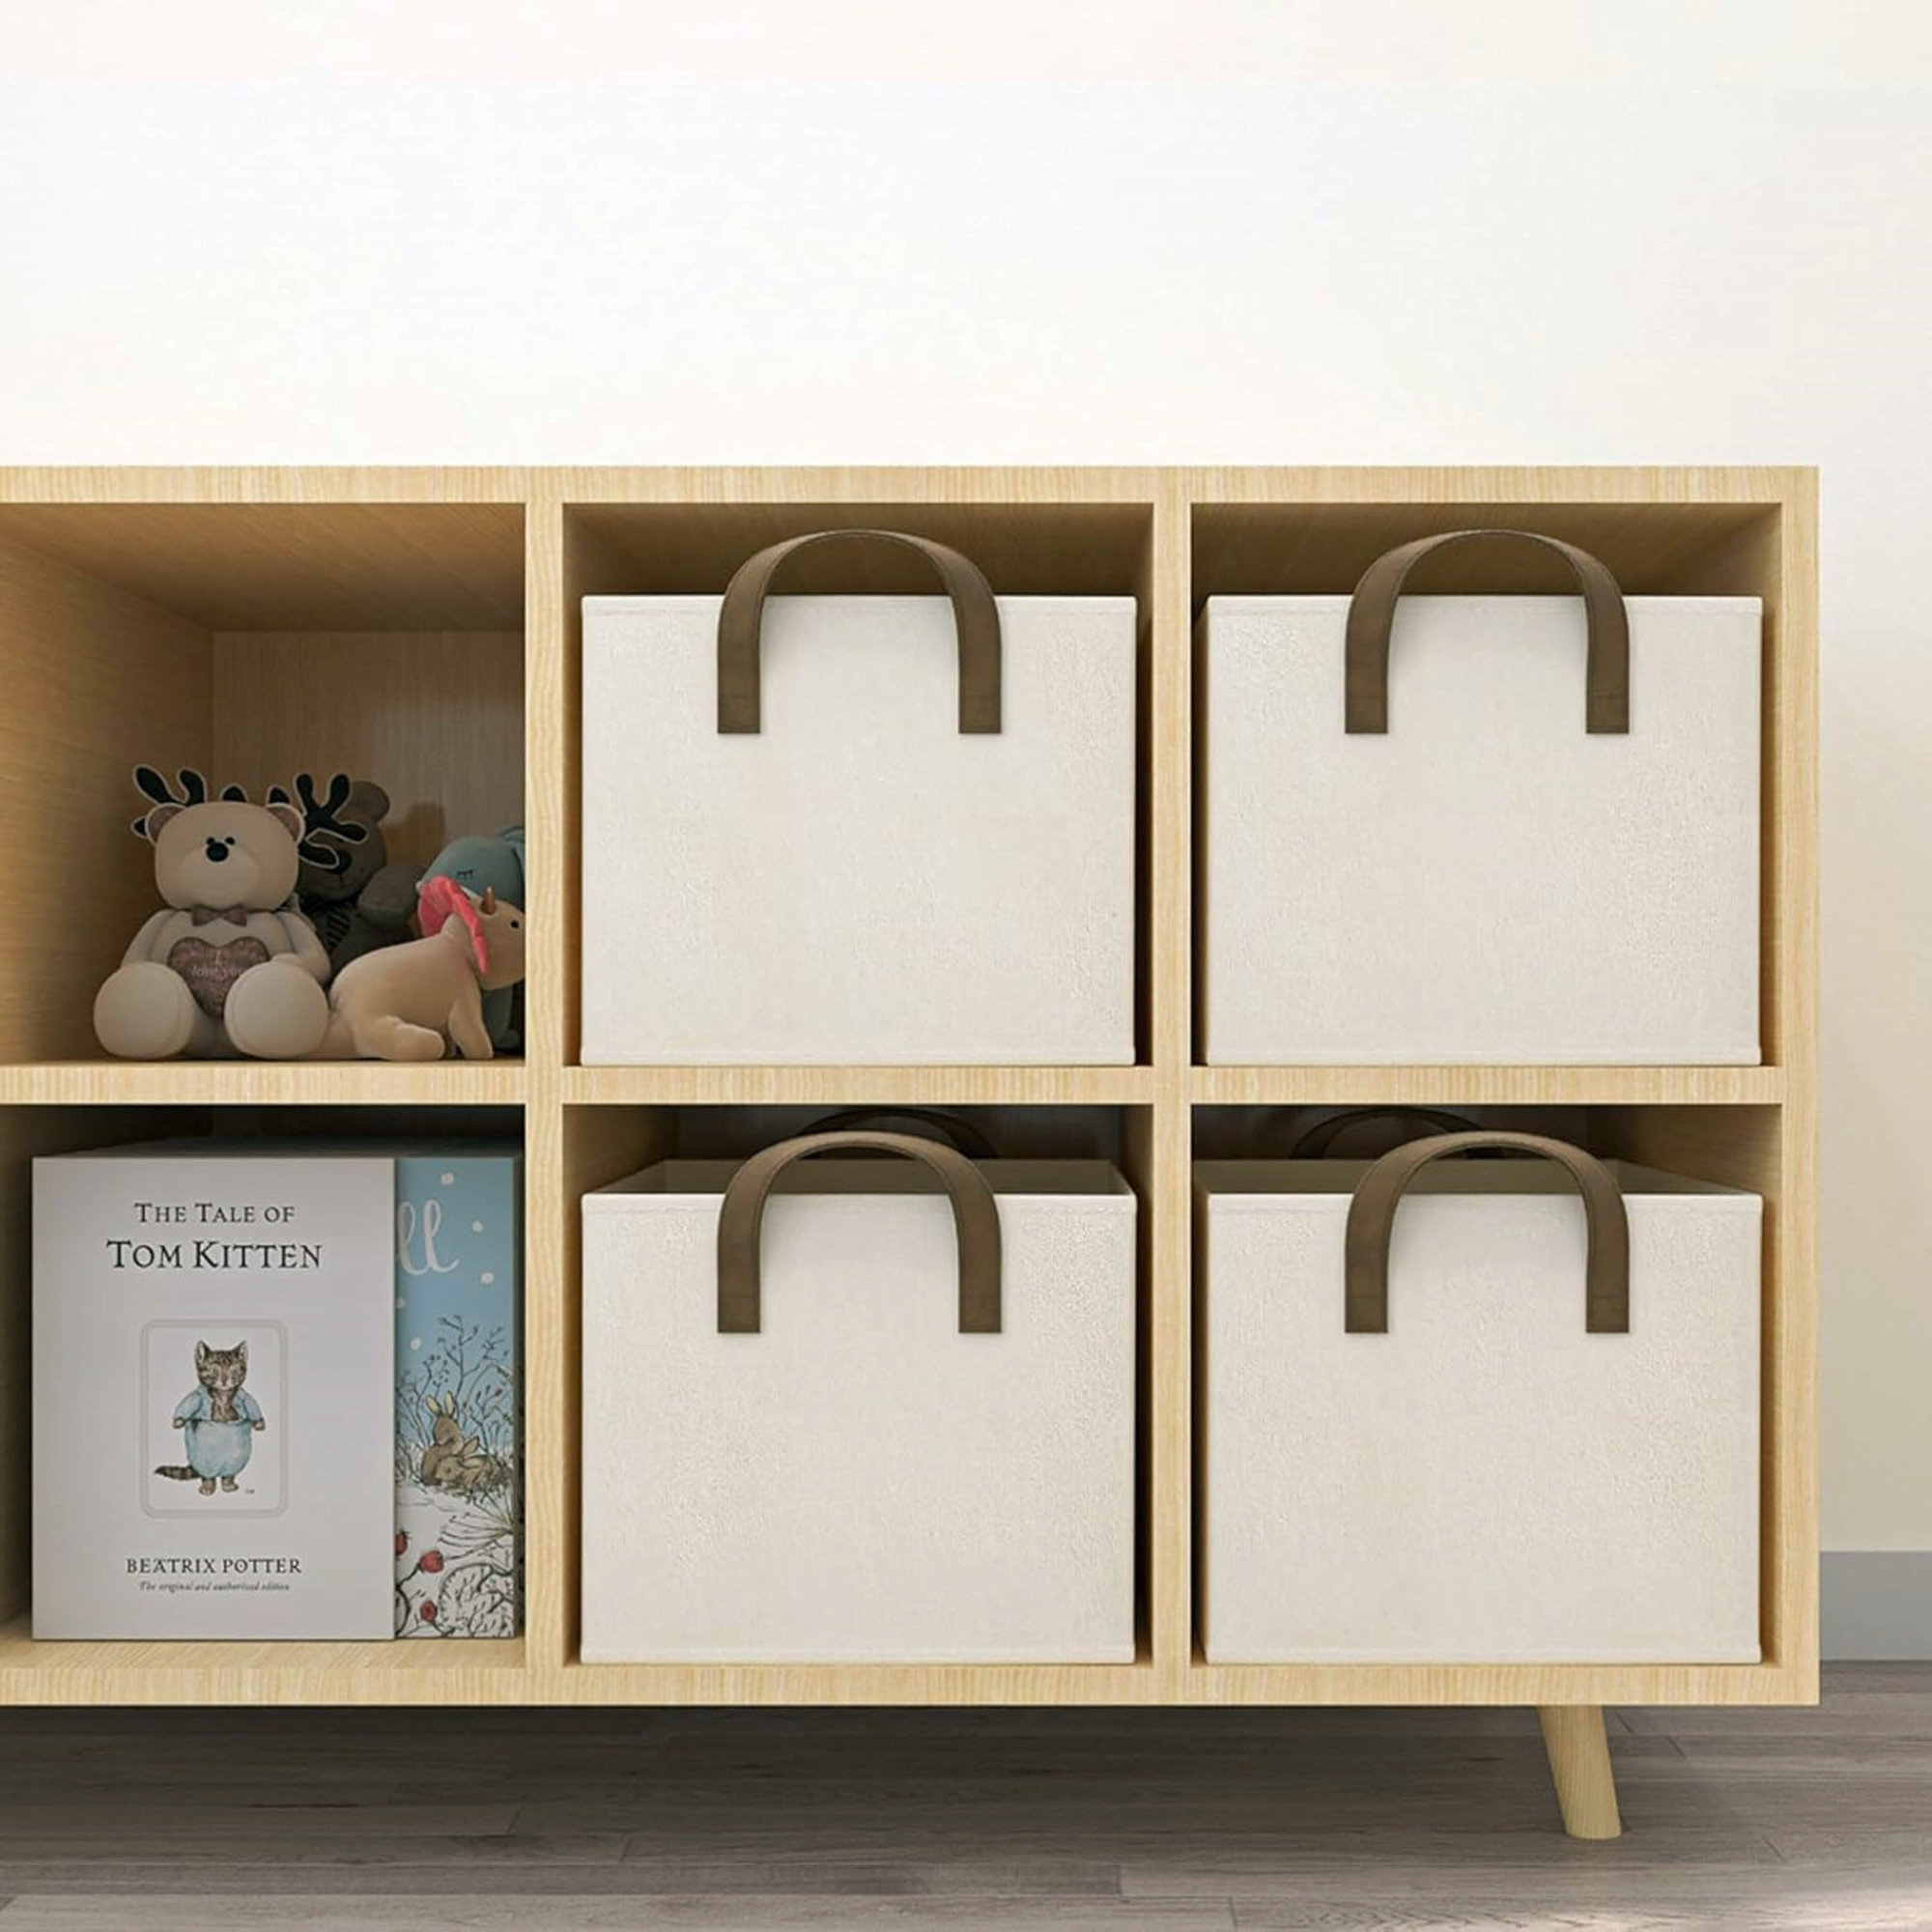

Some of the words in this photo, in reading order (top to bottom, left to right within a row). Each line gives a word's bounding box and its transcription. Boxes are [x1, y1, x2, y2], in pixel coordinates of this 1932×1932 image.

[264, 1206, 296, 1223] OF
[105, 1239, 185, 1269] TOM
[192, 1239, 324, 1269] KITTEN
[126, 1557, 217, 1575] BEATRIX
[221, 1557, 302, 1575] POTTER
[194, 1580, 212, 1592] and
